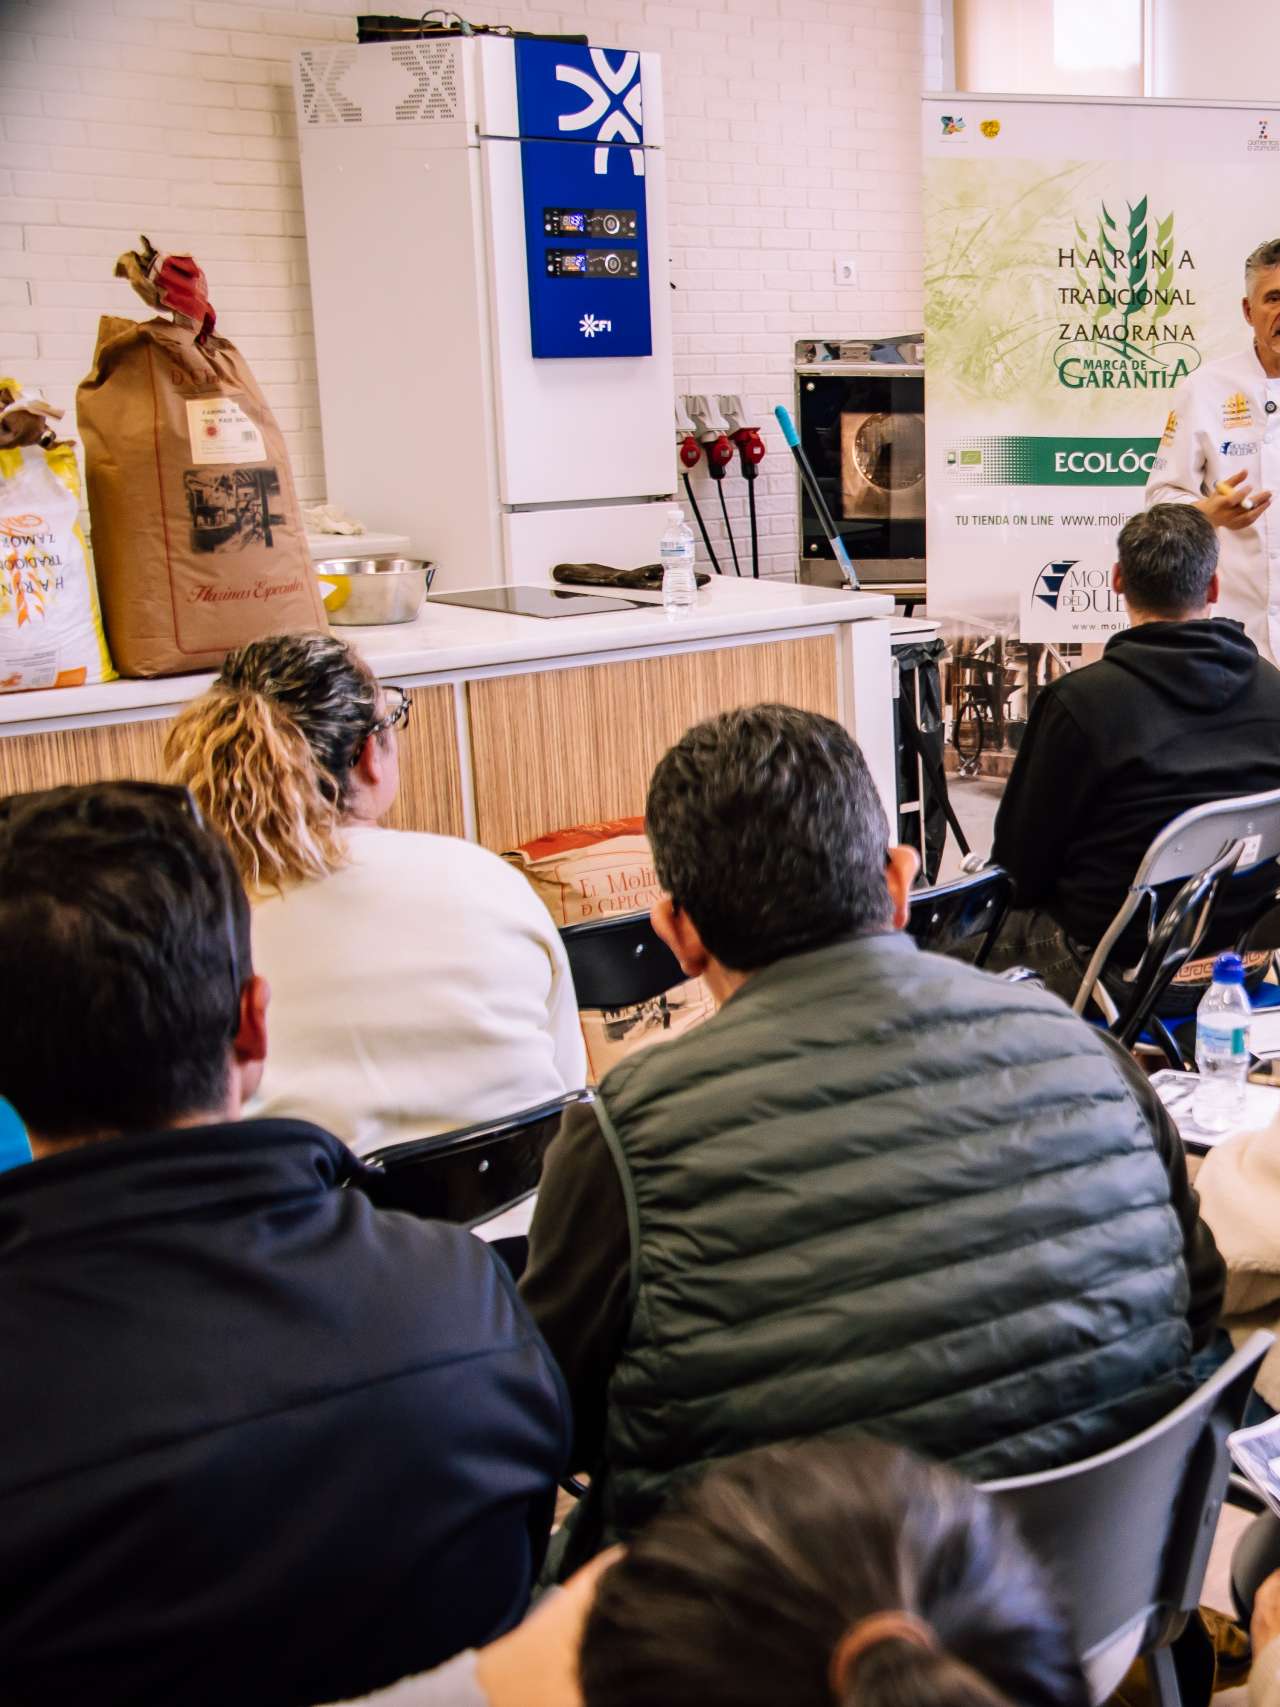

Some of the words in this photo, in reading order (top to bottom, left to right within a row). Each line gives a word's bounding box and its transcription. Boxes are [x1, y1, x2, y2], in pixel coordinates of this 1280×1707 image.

[1058, 248, 1195, 269] HARINA
[1058, 288, 1196, 305] TRADICIONAL
[1059, 324, 1195, 341] ZAMORANA
[1059, 358, 1188, 389] GARANTÍA
[1083, 359, 1128, 371] MARCA
[1132, 360, 1147, 371] DE
[955, 515, 969, 526] TU
[972, 515, 1010, 526] TIENDA
[1013, 515, 1028, 526] ON
[1031, 515, 1054, 526] LINE
